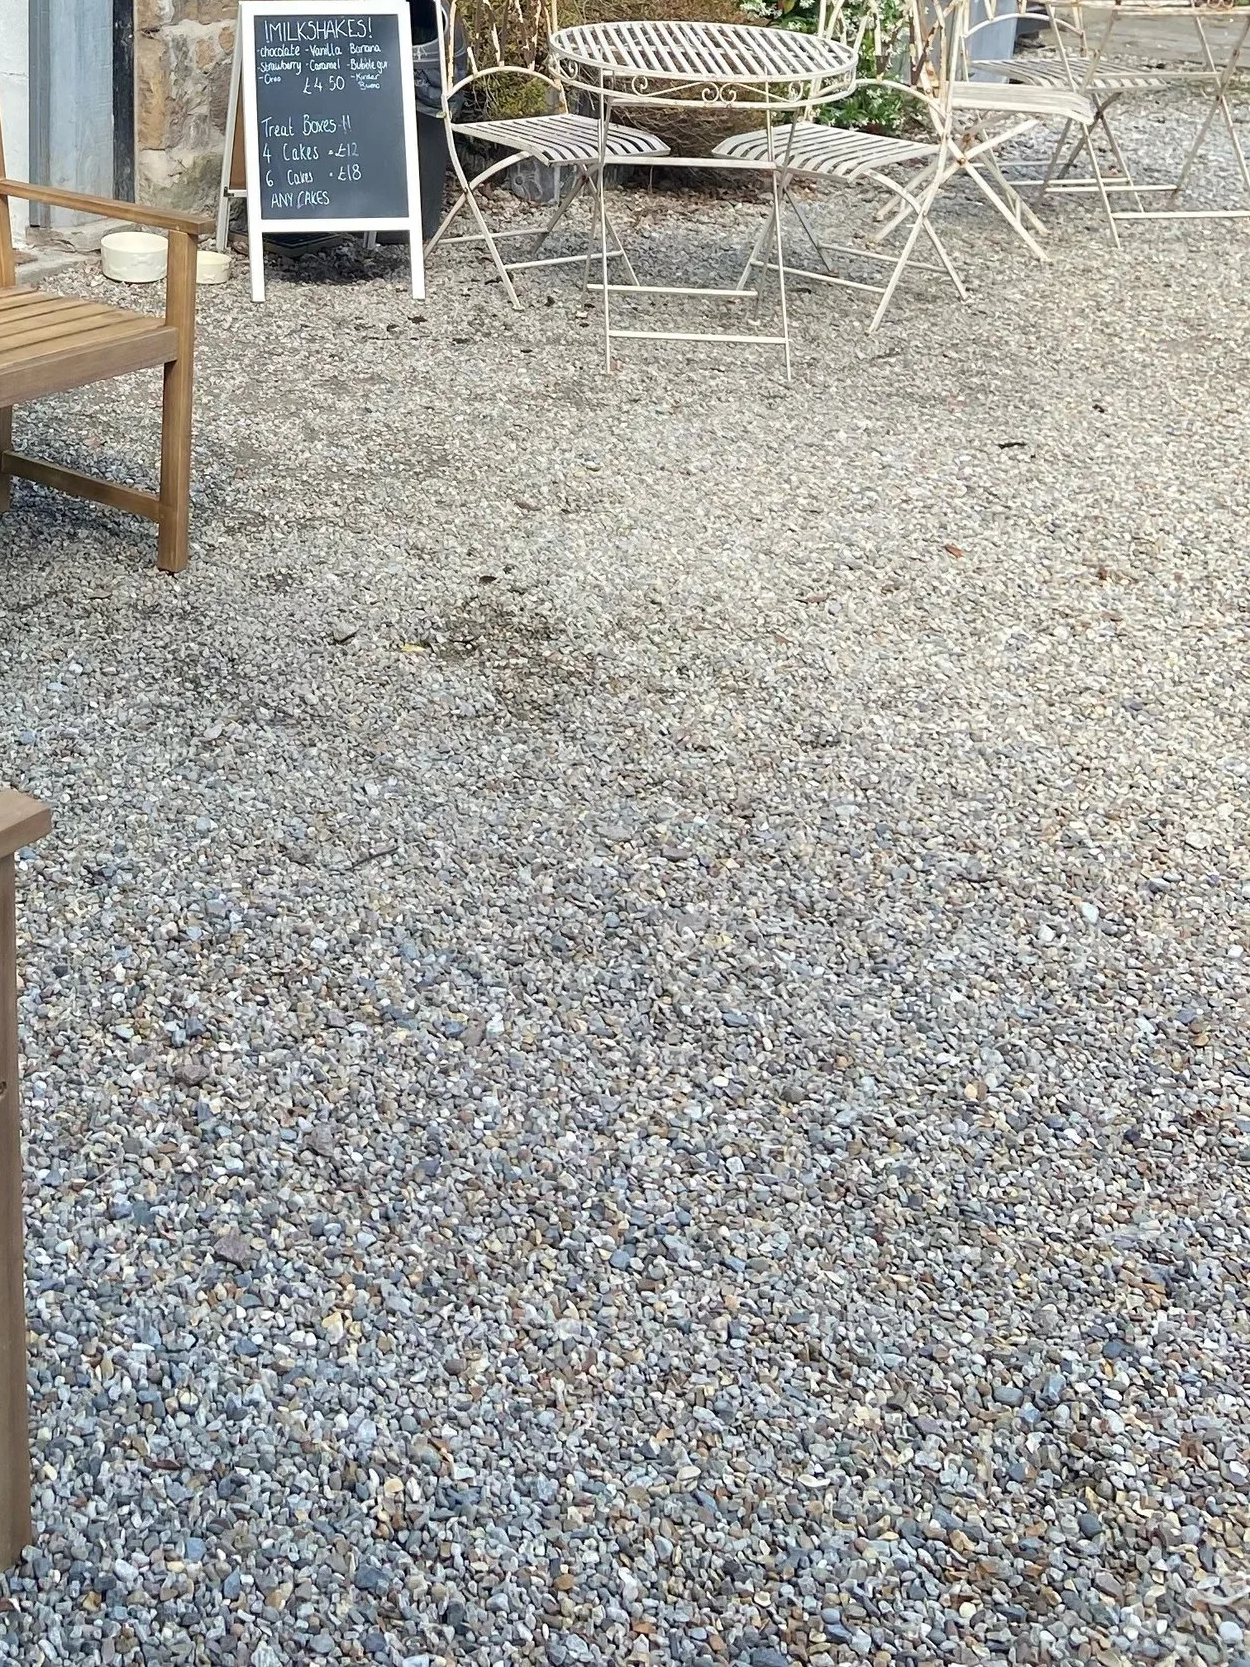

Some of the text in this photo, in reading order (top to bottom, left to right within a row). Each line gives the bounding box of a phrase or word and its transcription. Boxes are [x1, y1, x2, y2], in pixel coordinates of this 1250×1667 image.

[261, 116, 295, 137] Treat
[262, 143, 272, 163] 4
[282, 143, 319, 161] Cakes
[265, 170, 274, 187] 6
[271, 190, 330, 209] ANY CAKES
